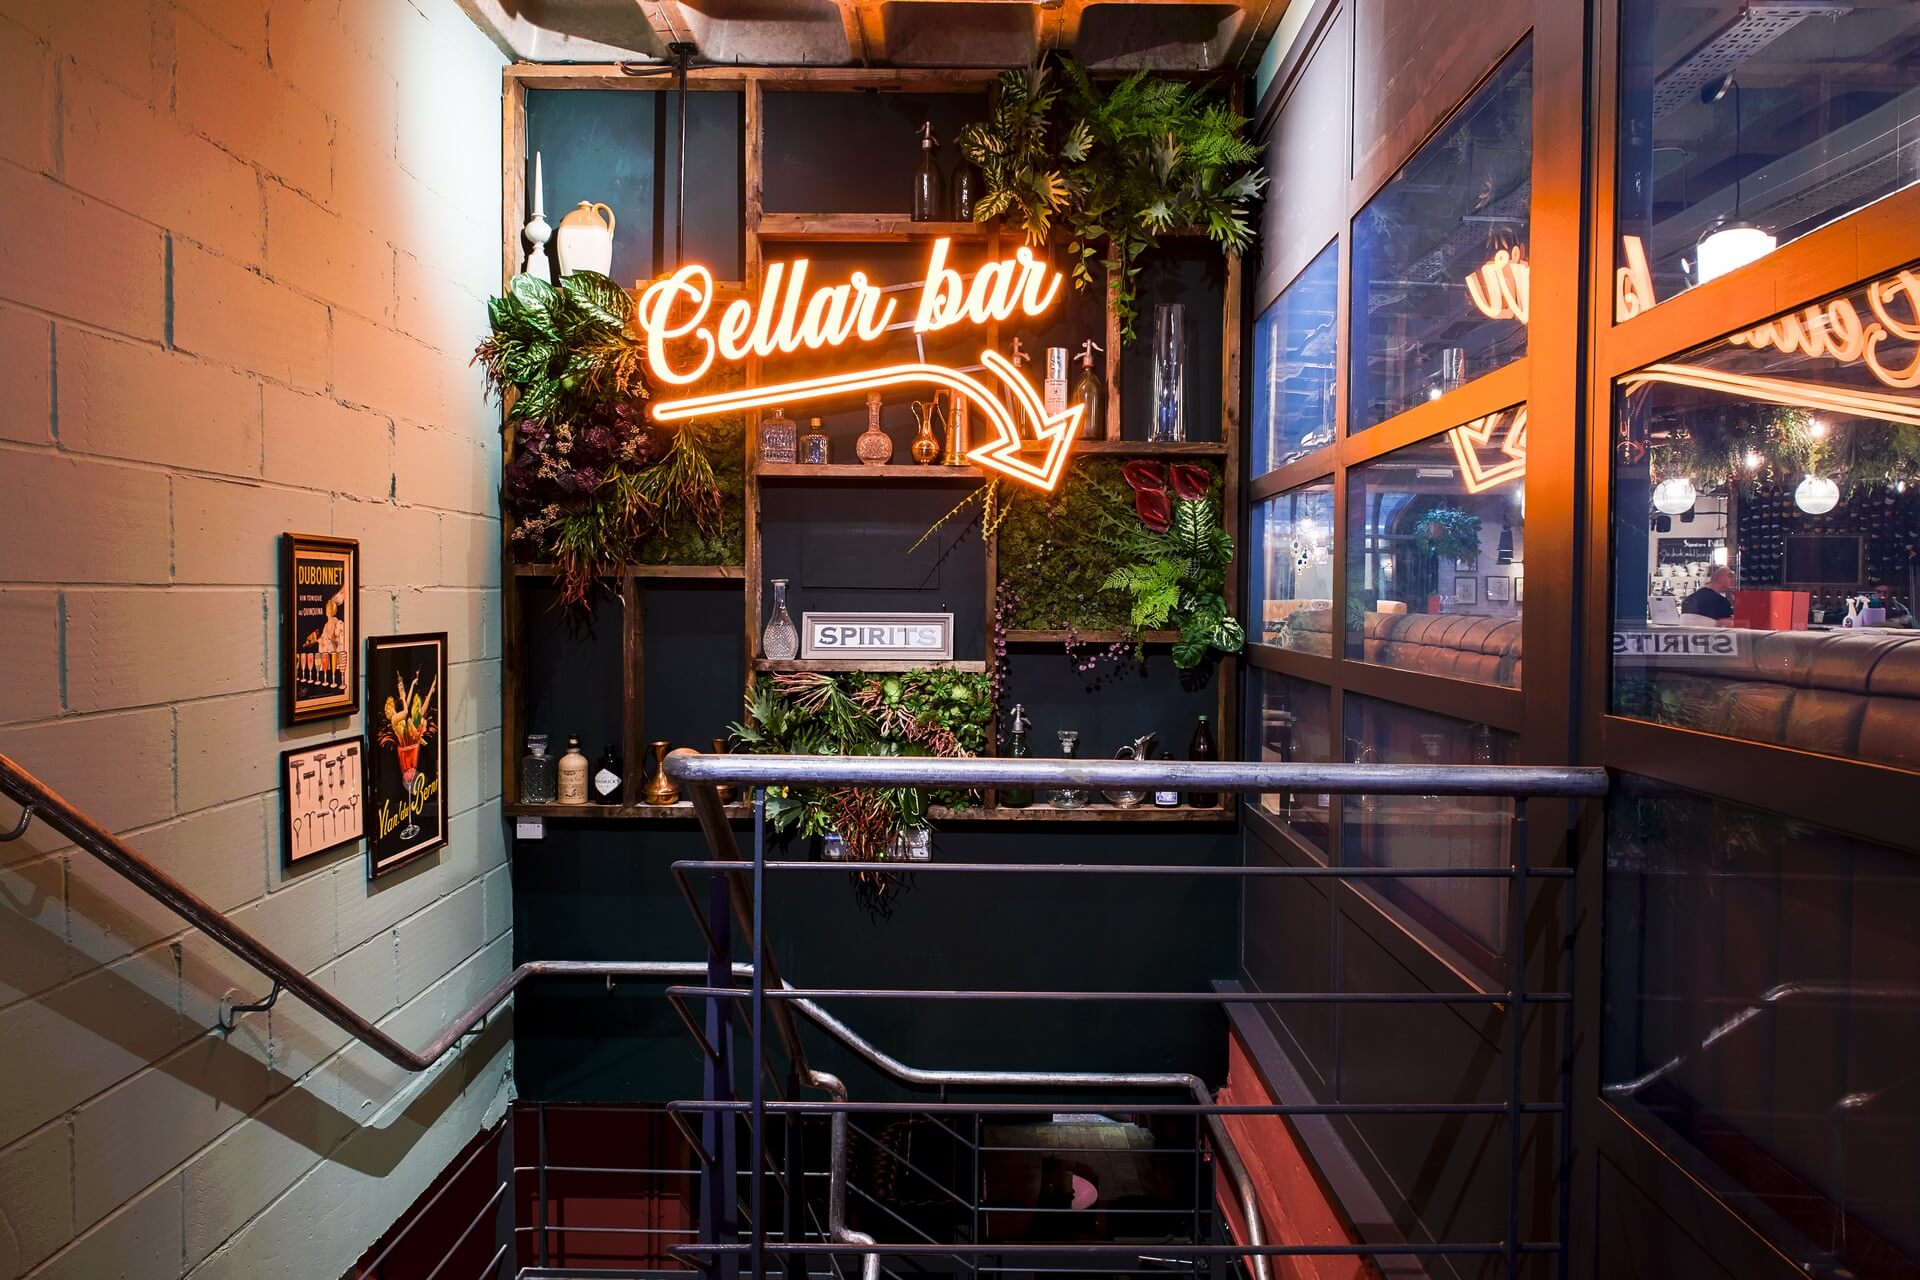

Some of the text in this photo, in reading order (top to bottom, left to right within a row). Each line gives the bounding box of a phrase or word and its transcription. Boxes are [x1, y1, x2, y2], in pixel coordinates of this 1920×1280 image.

[638, 237, 1063, 386] Cellar bar
[298, 566, 343, 585] DUBONNET
[819, 626, 937, 646] SPIRITS
